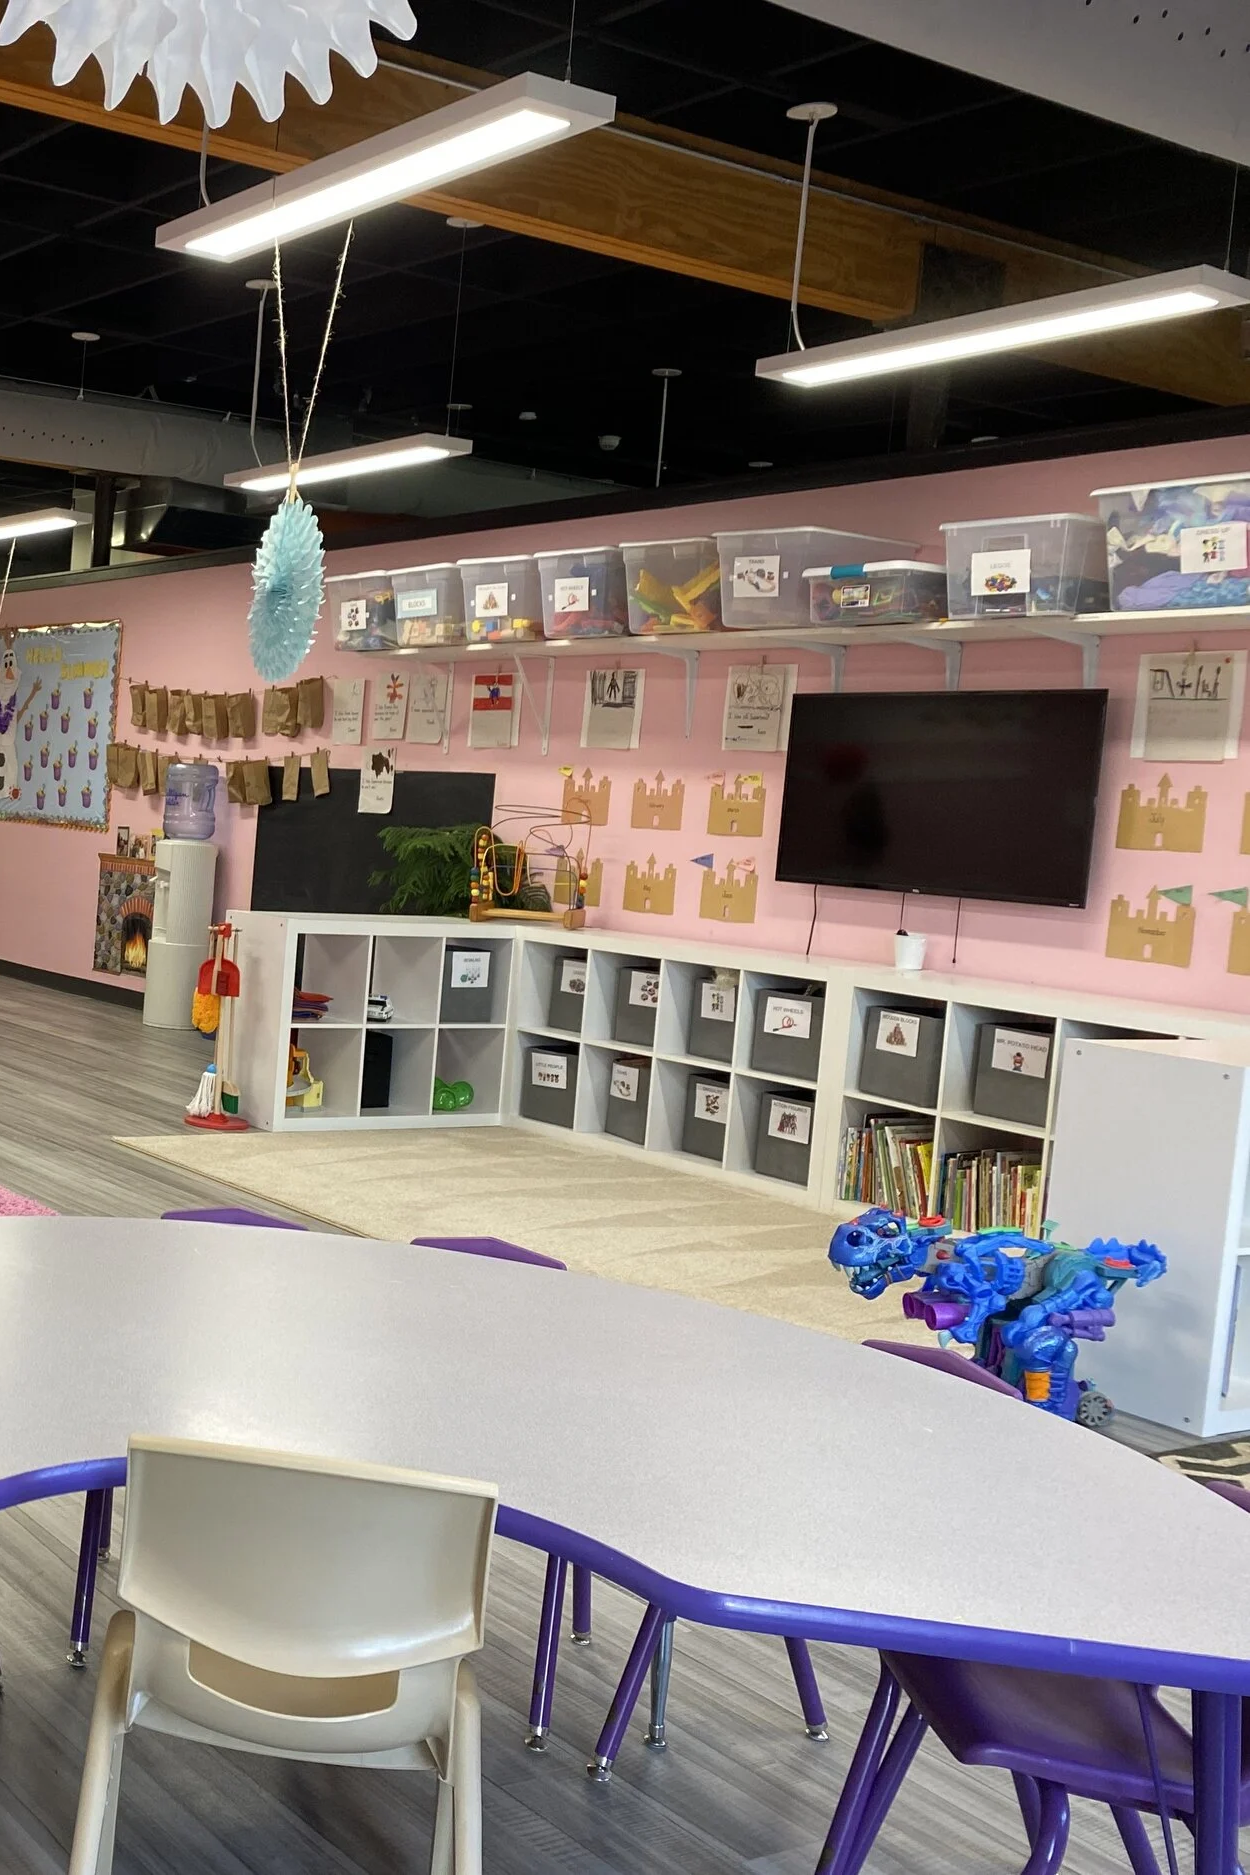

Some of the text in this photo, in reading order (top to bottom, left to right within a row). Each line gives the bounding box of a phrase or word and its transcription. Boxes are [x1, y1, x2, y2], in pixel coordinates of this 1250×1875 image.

[407, 599, 426, 609] BLOCKS
[1149, 812, 1165, 826] July
[783, 1007, 804, 1015] WHEELS
[882, 1014, 918, 1025] WOODEN BLOCKS
[1007, 1039, 1030, 1050] POTATO
[1030, 1043, 1048, 1054] HEAD
[774, 1101, 788, 1110] ACTION
